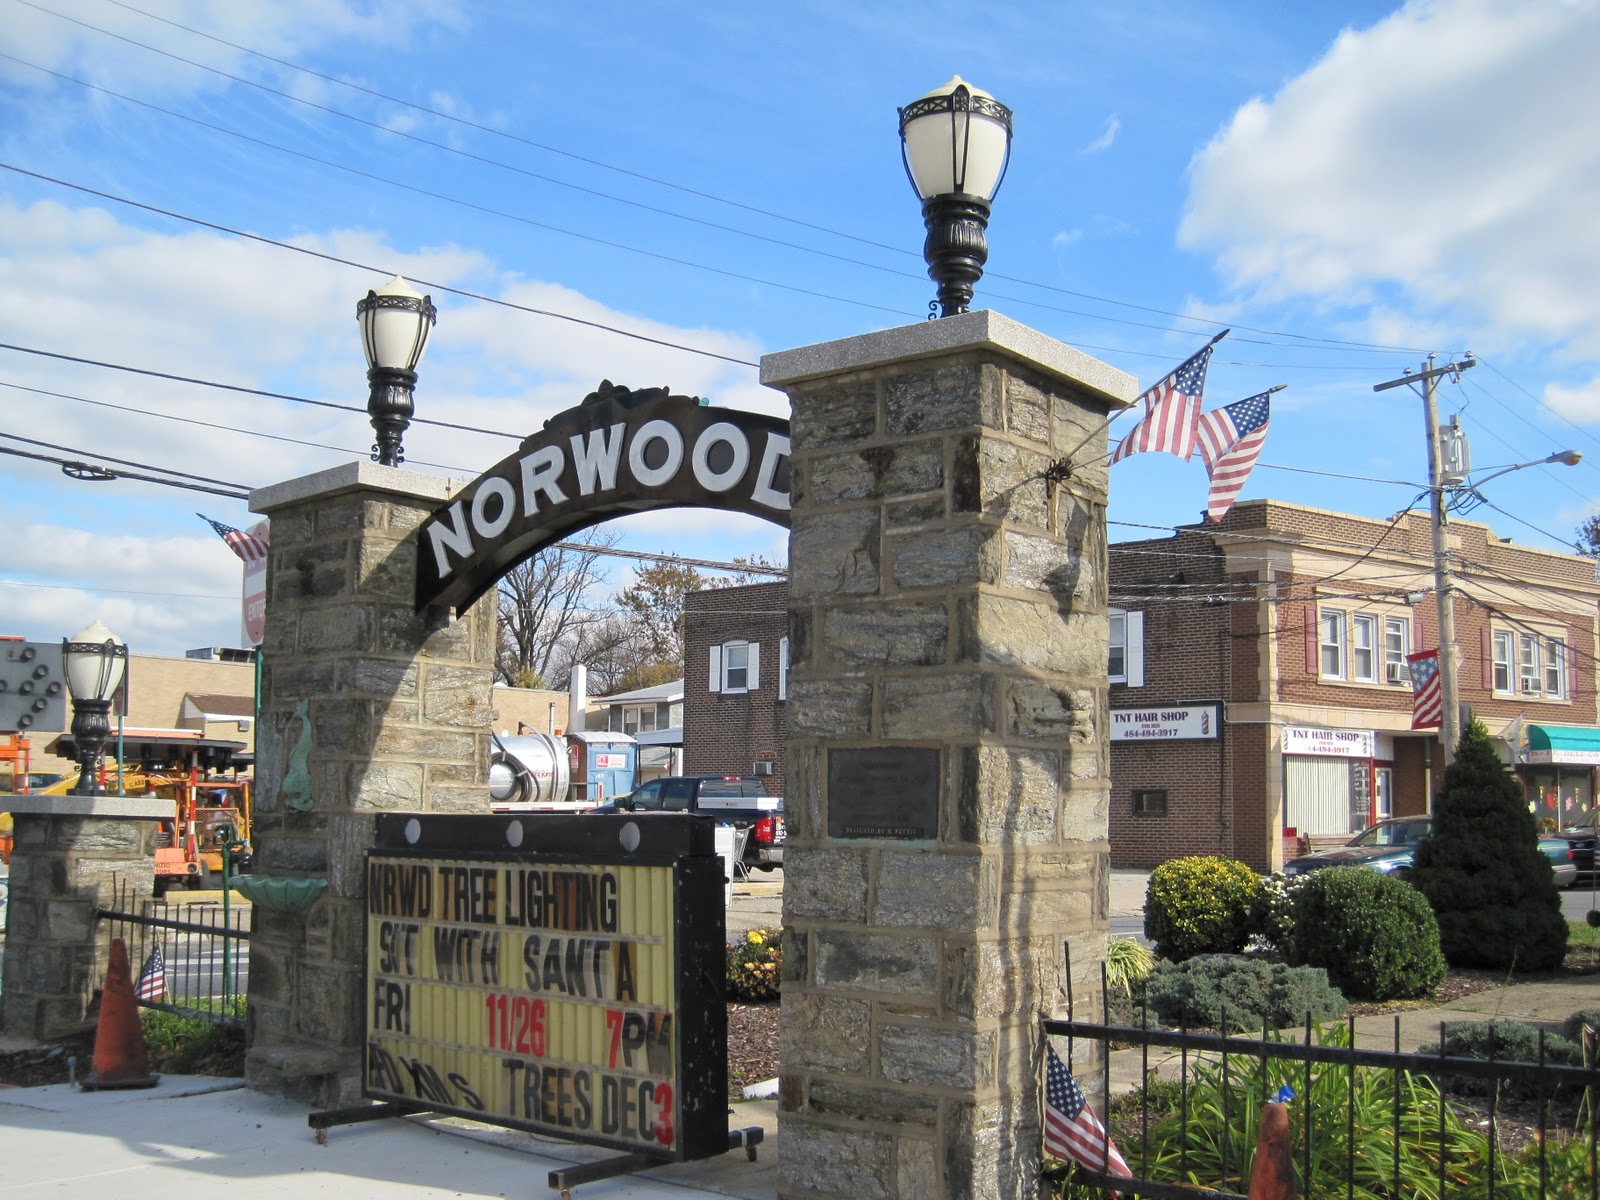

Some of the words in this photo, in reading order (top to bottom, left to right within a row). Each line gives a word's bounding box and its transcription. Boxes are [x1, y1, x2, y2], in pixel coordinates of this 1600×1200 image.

[1113, 713, 1132, 723] TNT
[1134, 712, 1158, 723] HAIR
[1160, 711, 1189, 722] SHOP
[1123, 729, 1179, 738] 484-494-3917
[1292, 729, 1309, 739] TNT
[1311, 731, 1333, 740] HAIR
[1335, 732, 1359, 742] SHOP
[1304, 745, 1350, 754] 4-494-3917
[439, 866, 497, 923] TREE
[505, 869, 617, 933] LIGHTING
[380, 921, 419, 976] SIT
[434, 926, 499, 986] WITH
[523, 934, 637, 1001] SANTA
[374, 978, 411, 1036] FRI
[486, 993, 546, 1058] 11/26
[502, 1058, 592, 1130] TREES
